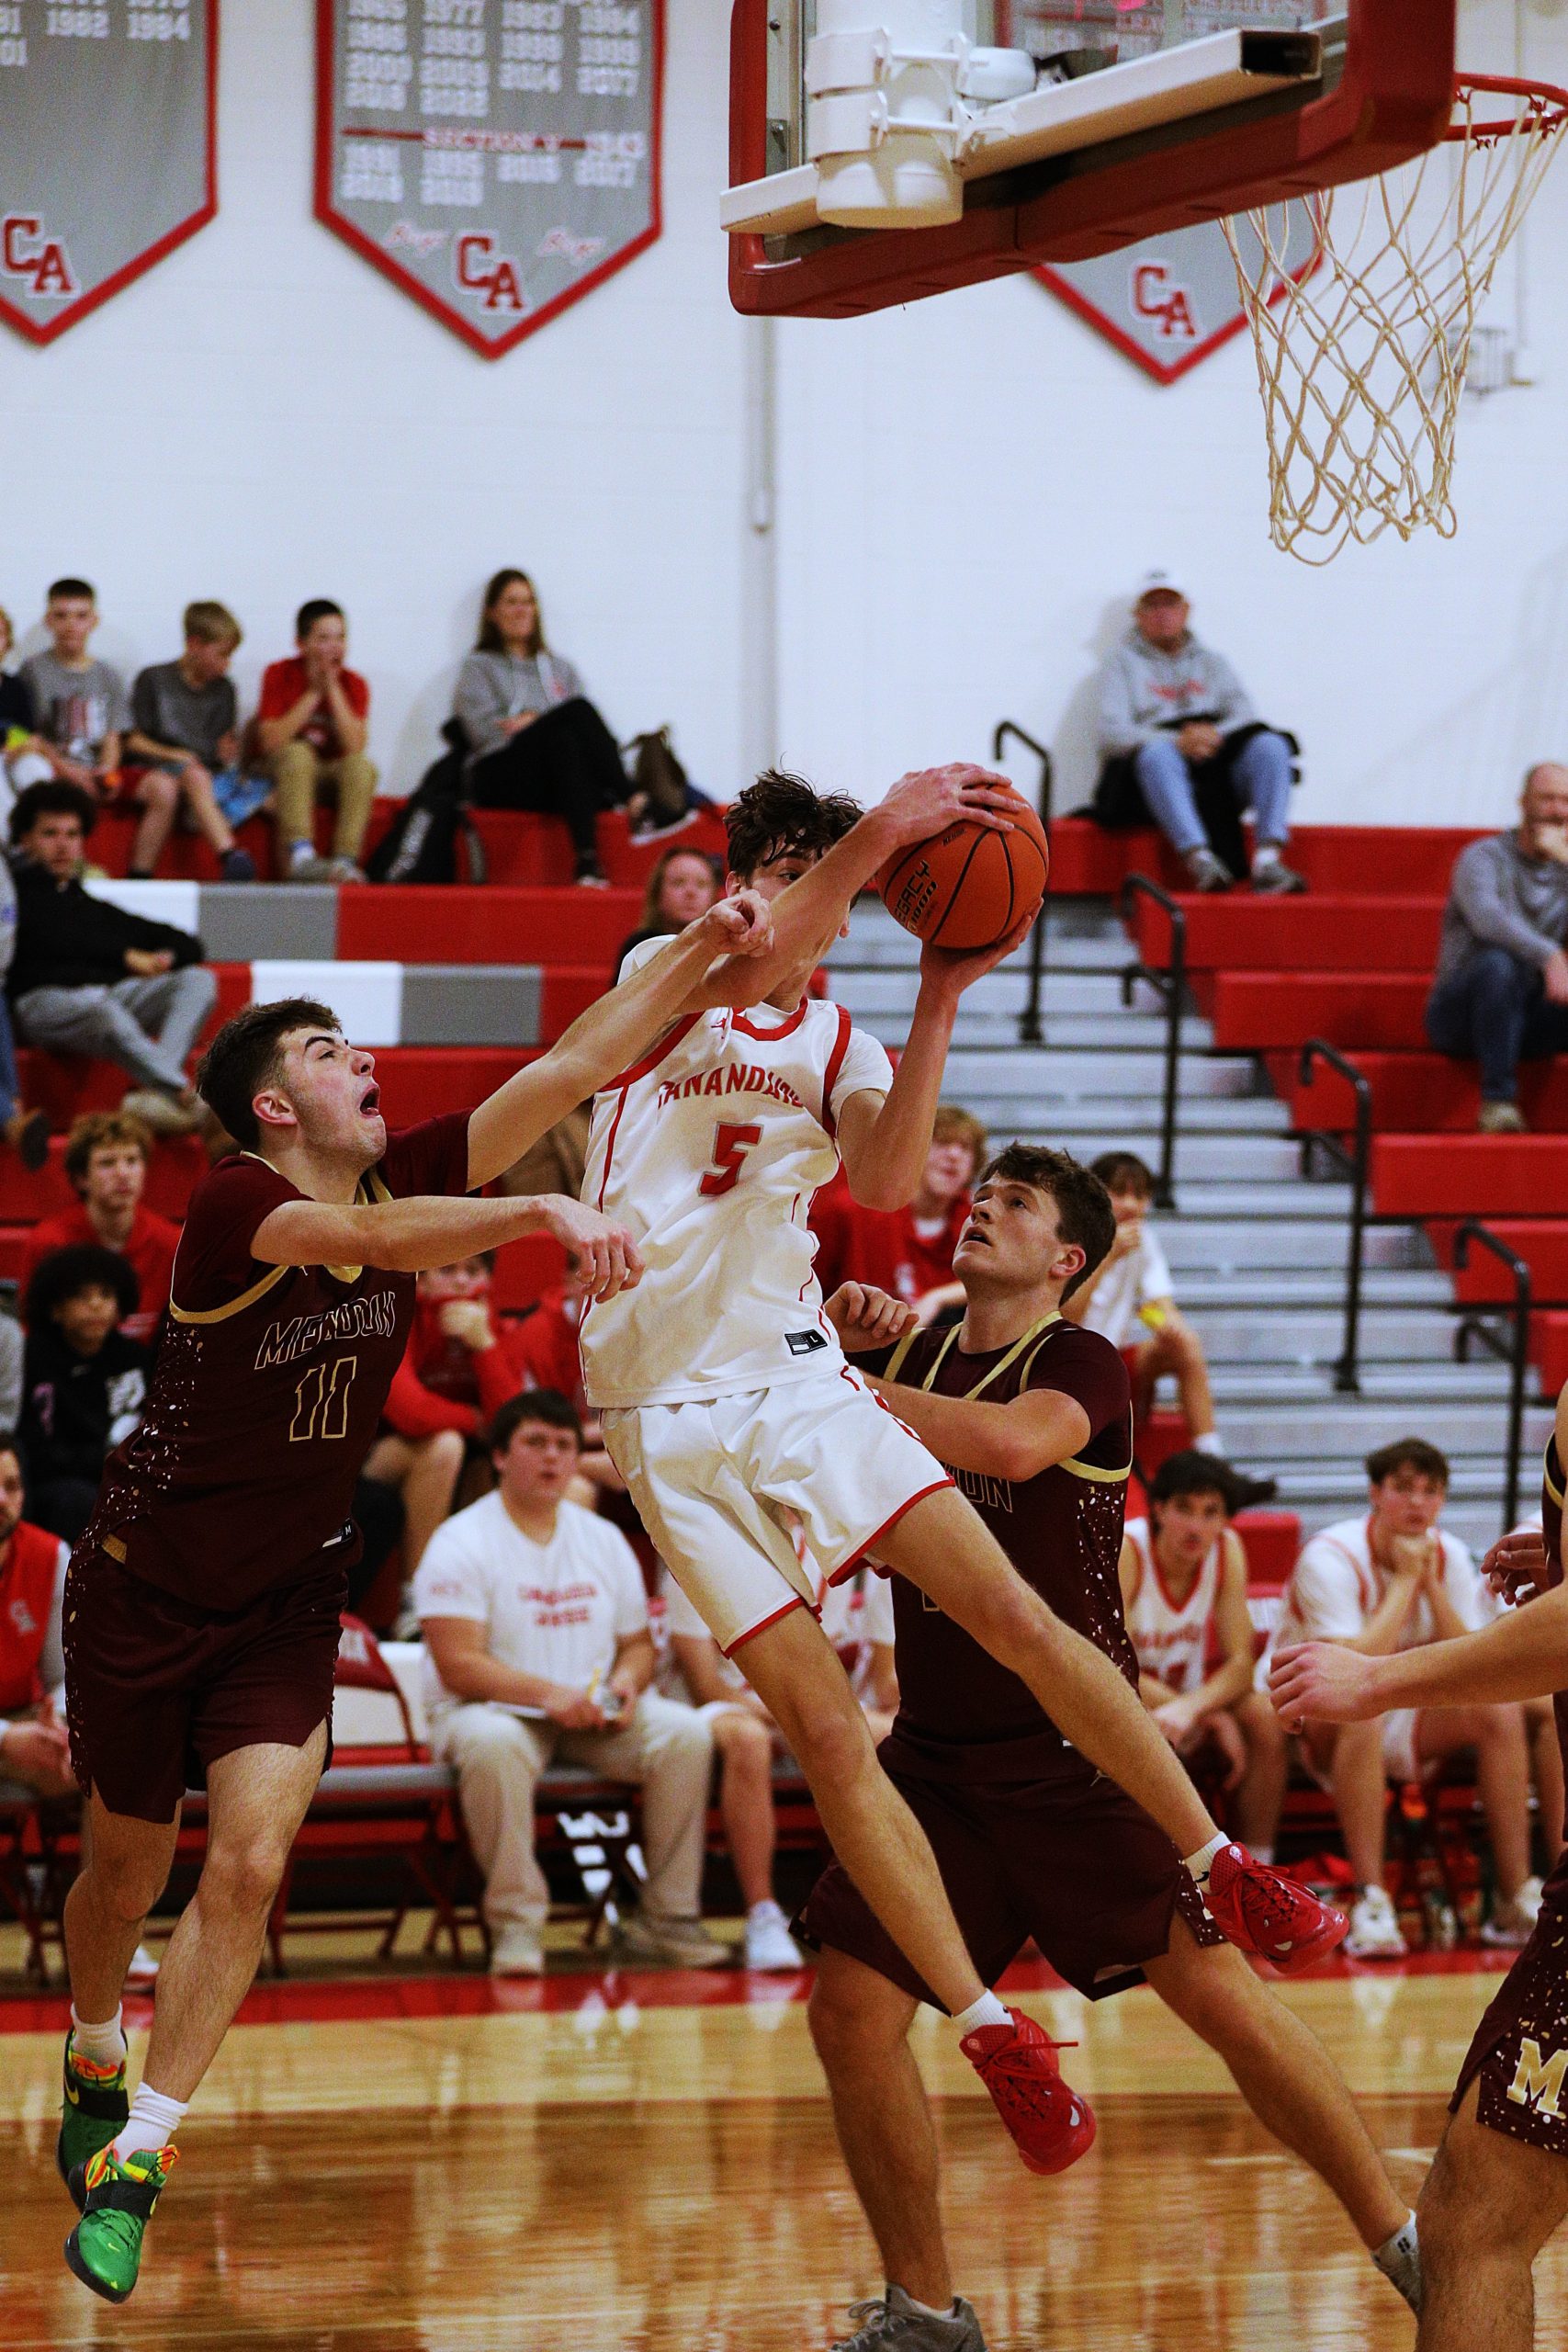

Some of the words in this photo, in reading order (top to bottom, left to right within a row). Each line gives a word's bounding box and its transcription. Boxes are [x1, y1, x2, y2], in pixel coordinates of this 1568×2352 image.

[4, 217, 72, 292] CA
[457, 235, 524, 310] CA
[1133, 265, 1196, 337] CA
[698, 1121, 764, 1197] 5
[289, 1355, 357, 1442] 11
[1506, 2037, 1568, 2117] M
